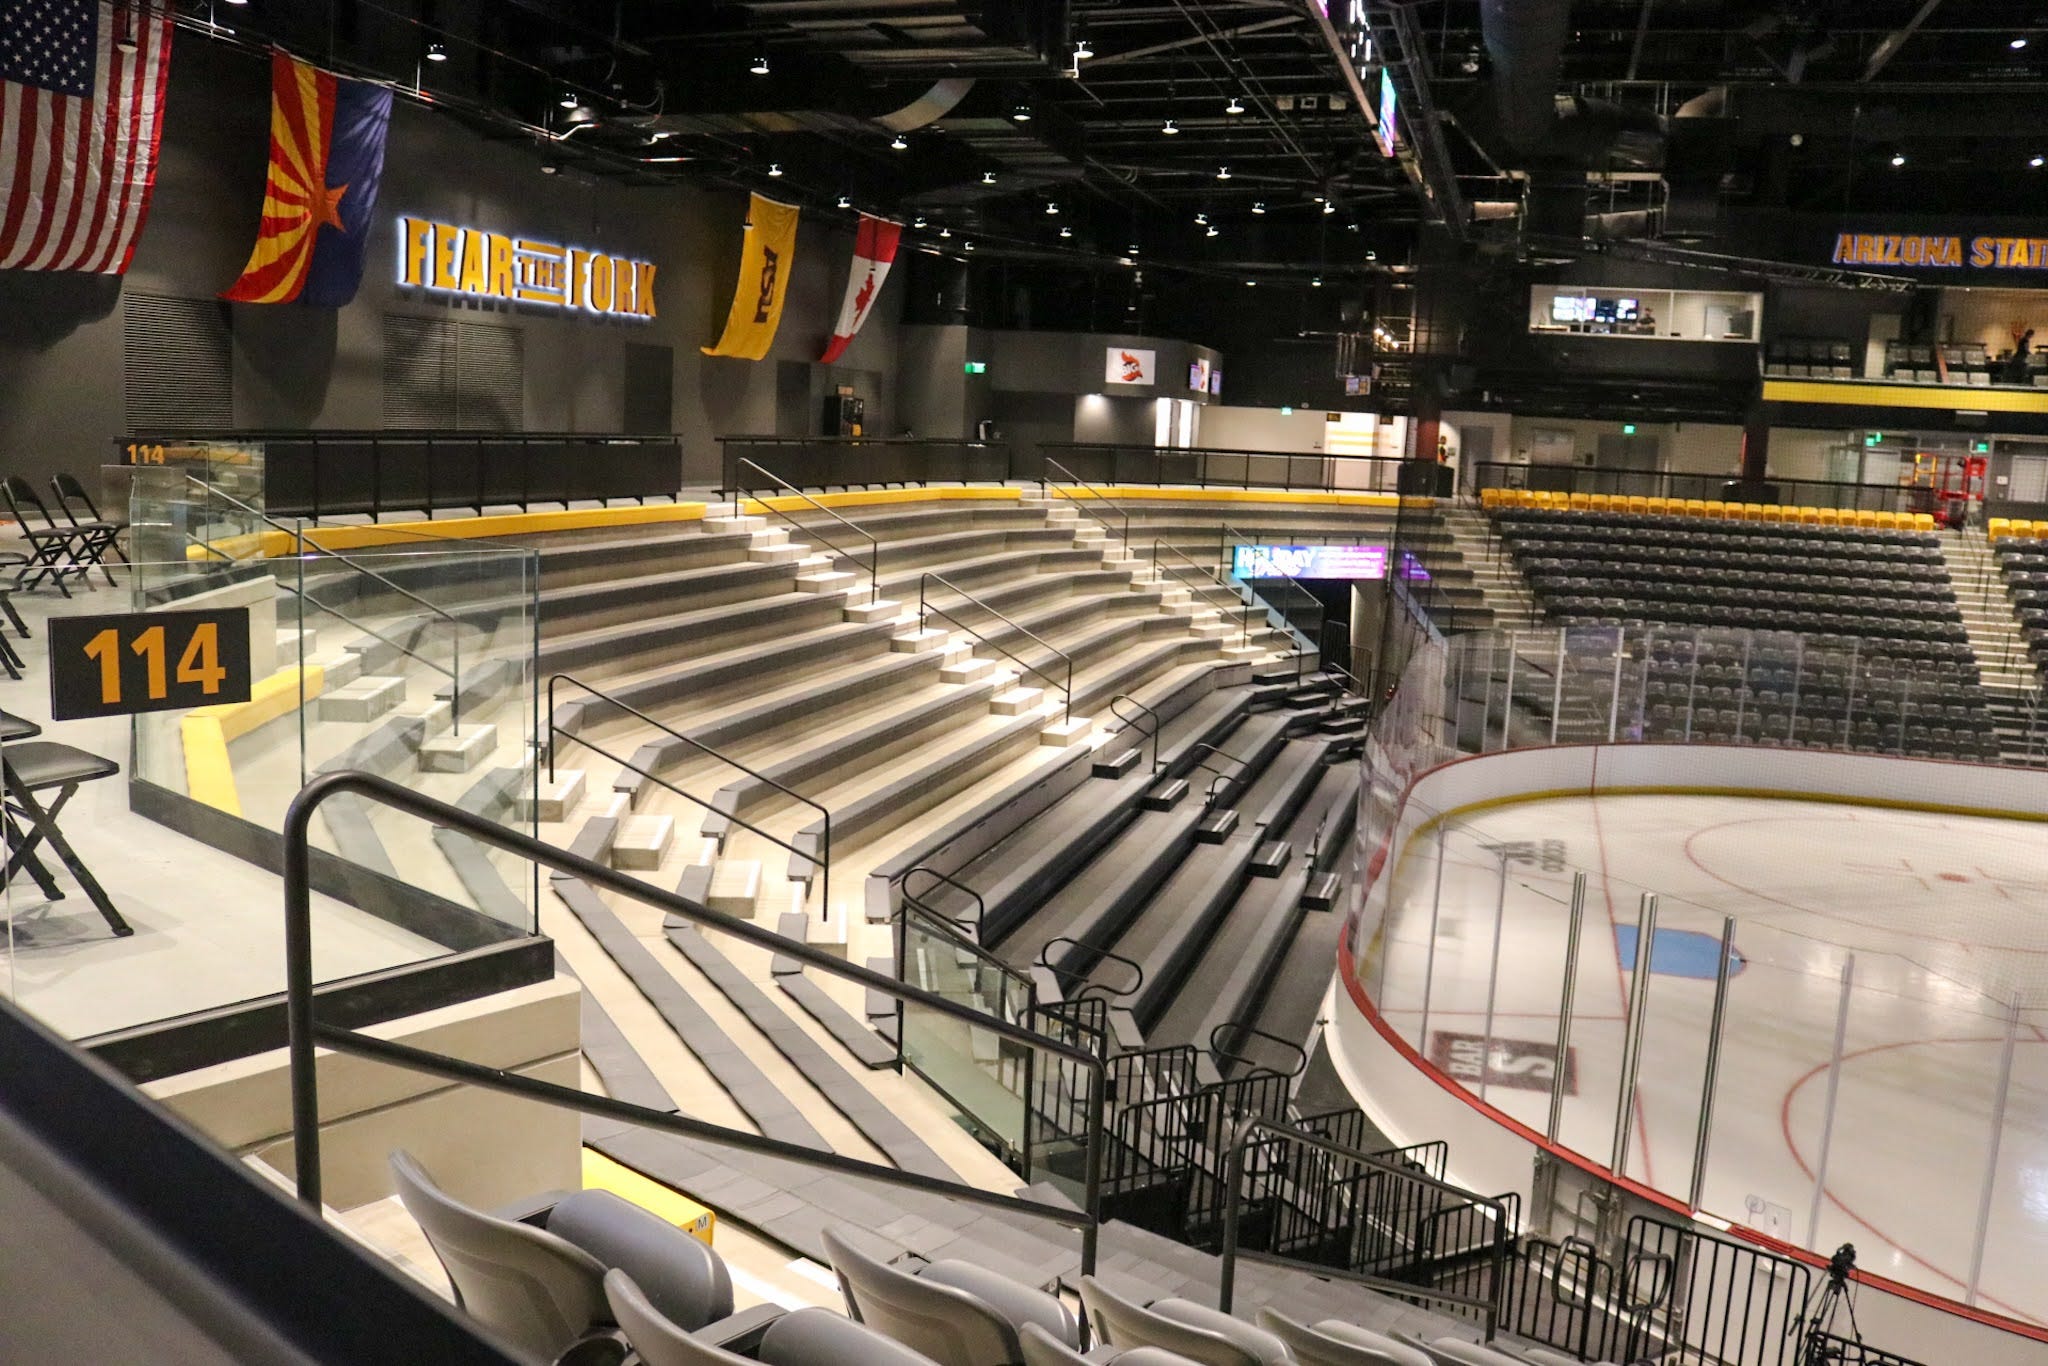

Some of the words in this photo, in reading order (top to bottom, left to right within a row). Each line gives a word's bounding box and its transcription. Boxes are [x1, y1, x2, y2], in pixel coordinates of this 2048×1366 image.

[400, 217, 514, 298] FEAR
[517, 256, 566, 290] THE
[570, 248, 657, 317] FORK
[753, 244, 778, 323] ASU
[1833, 233, 1963, 267] ARIZONA
[1970, 236, 2048, 268] STAT
[127, 444, 165, 465] 114
[83, 622, 226, 704] 114
